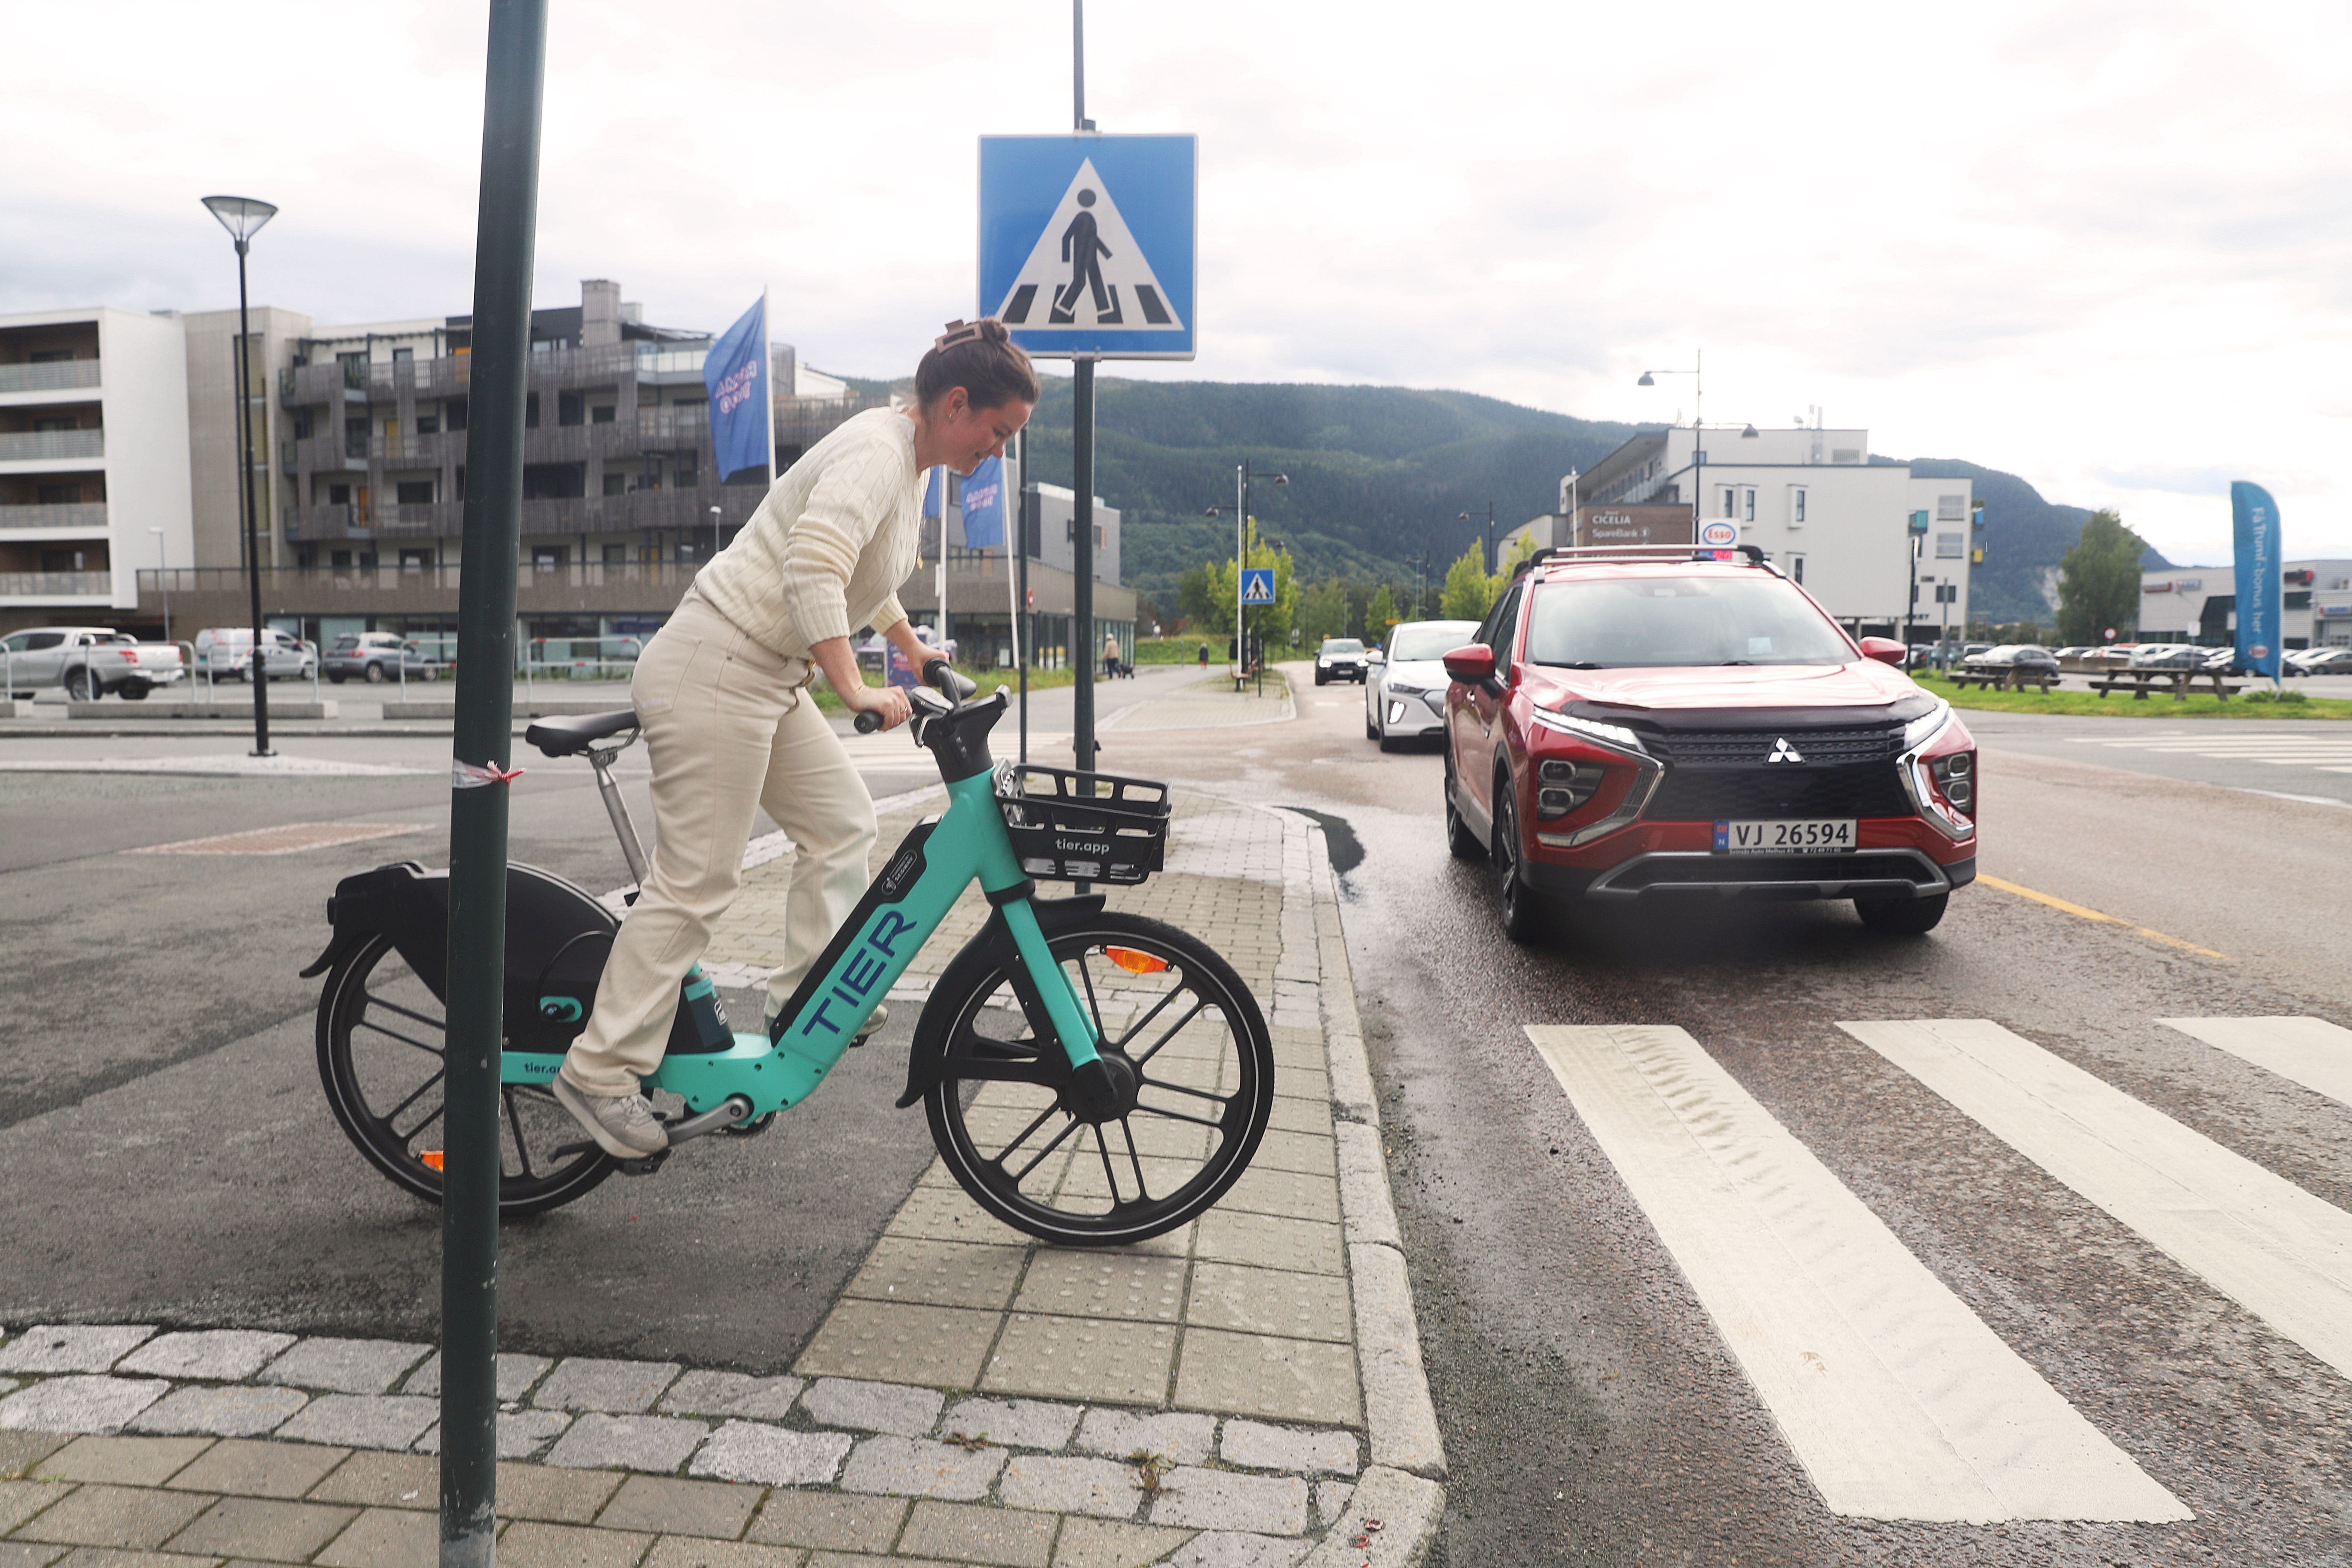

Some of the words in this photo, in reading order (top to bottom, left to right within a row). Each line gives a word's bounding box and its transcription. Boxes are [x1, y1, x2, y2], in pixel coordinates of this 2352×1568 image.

[1592, 515, 1631, 525] CICELIA
[1708, 528, 1731, 538] Esso
[2252, 611, 2265, 633] her
[1736, 825, 1762, 845] VJ
[1775, 823, 1849, 845] 26594
[1055, 838, 1110, 855] tier.app
[802, 910, 917, 1037] TIER
